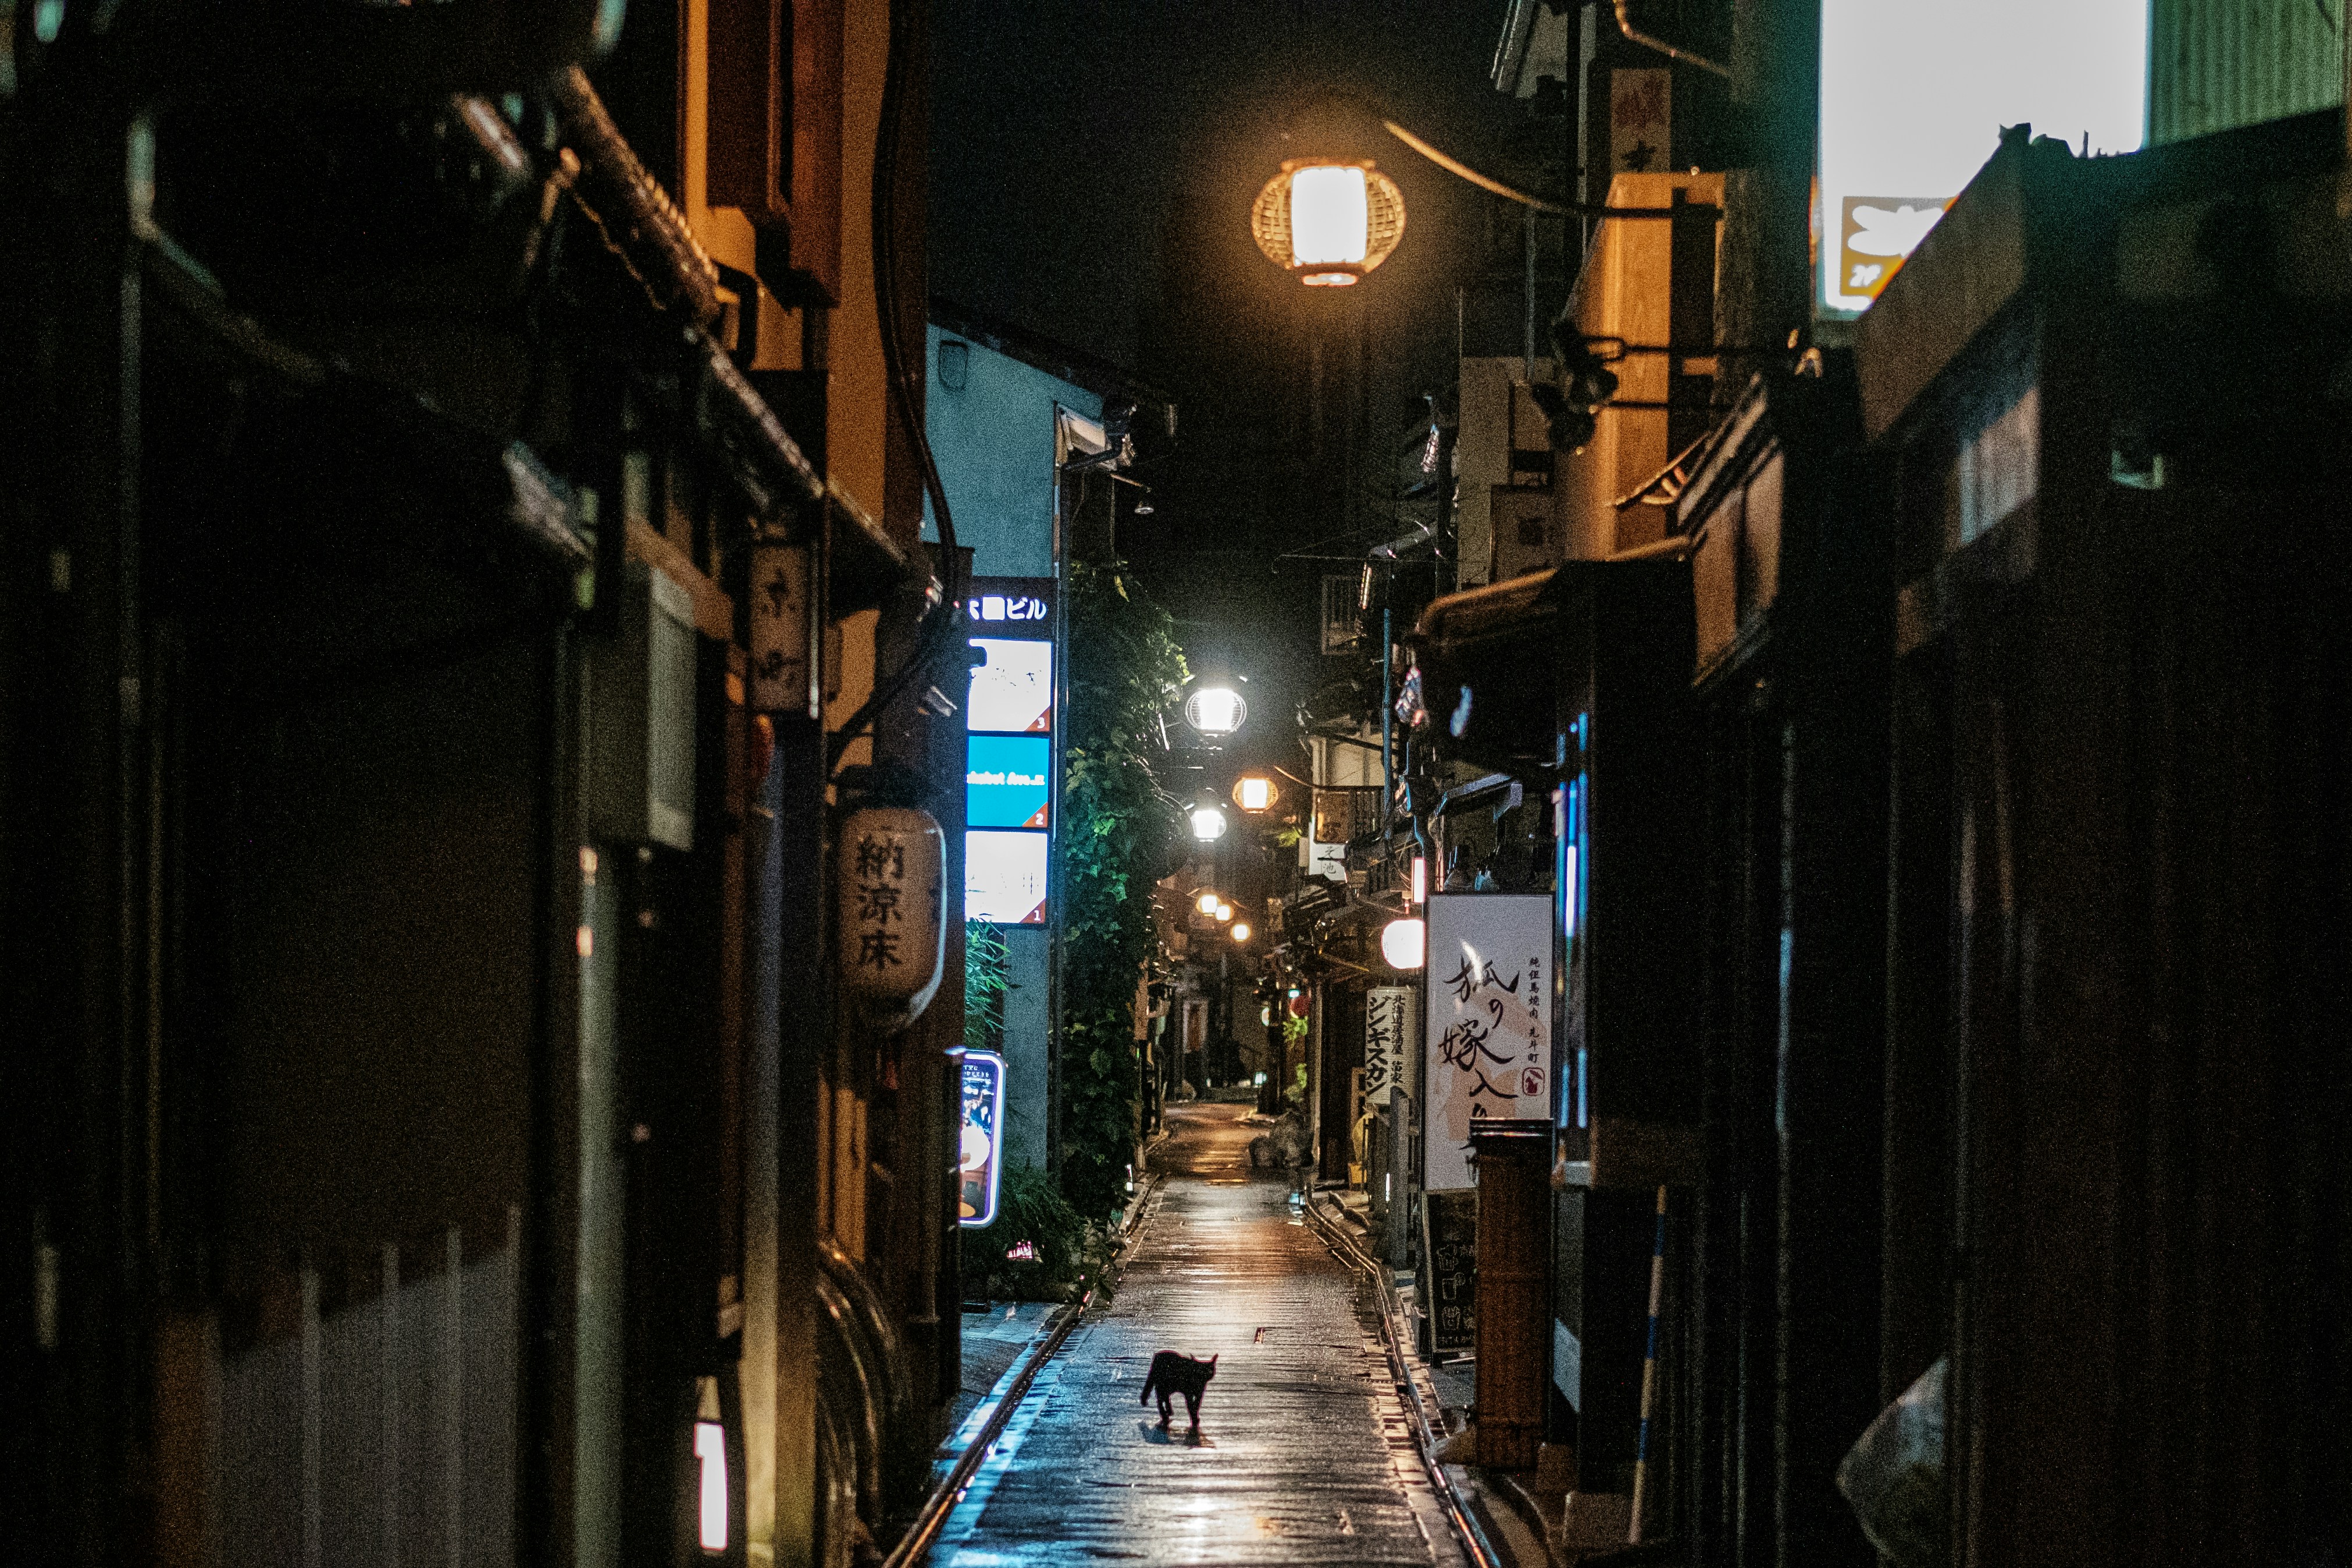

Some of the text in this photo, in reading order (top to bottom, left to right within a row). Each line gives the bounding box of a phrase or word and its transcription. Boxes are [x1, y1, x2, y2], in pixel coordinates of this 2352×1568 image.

[1037, 717, 1045, 729] 3
[1036, 814, 1044, 825] 2
[857, 834, 904, 970] 納涼床
[1034, 910, 1041, 921] 1
[1367, 995, 1392, 1097] ジンギスカン
[1528, 1026, 1540, 1063] 先斗町
